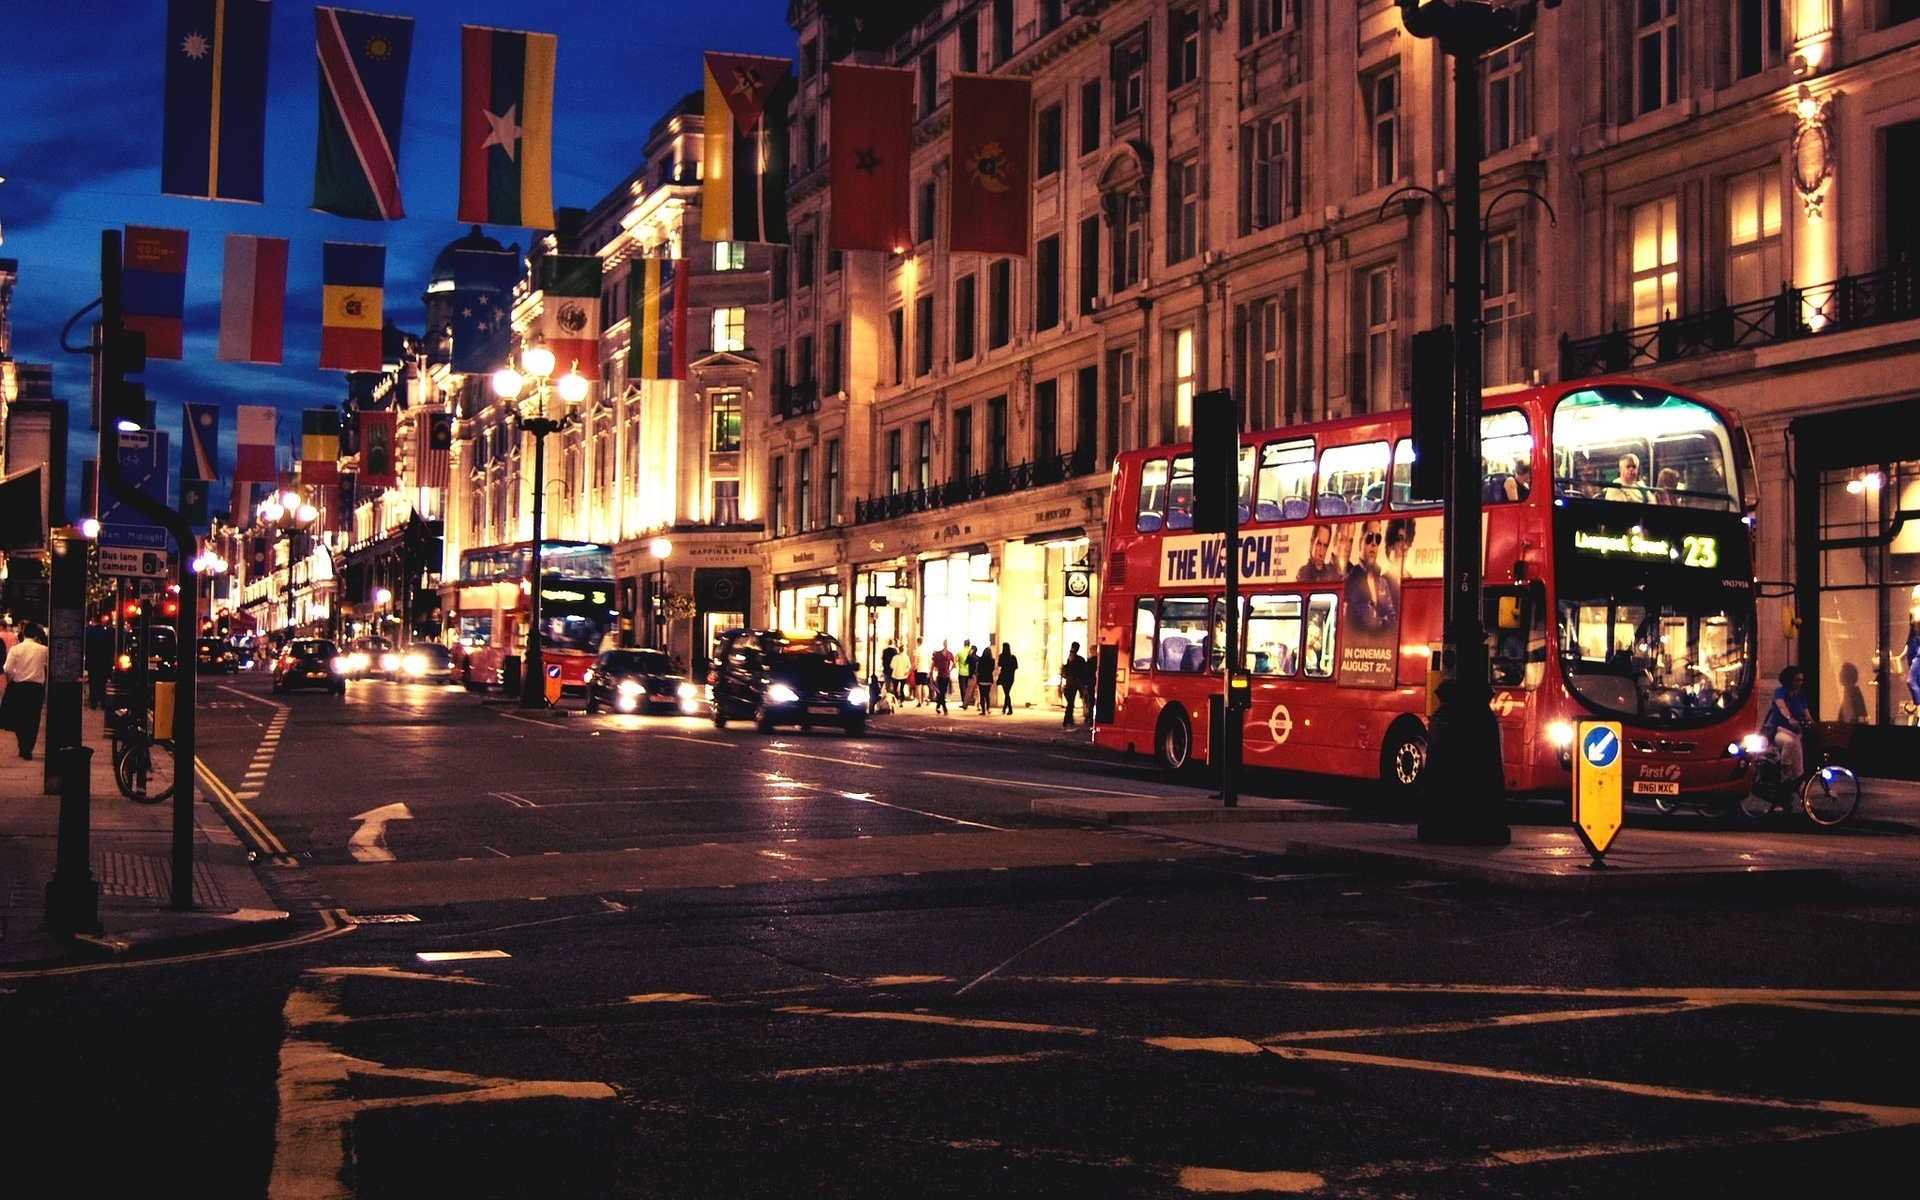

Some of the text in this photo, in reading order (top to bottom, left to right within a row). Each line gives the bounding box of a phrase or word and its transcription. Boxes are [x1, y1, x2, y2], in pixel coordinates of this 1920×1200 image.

[128, 532, 162, 542] Midnight
[102, 550, 138, 561] Bus lane
[1683, 535, 1717, 568] 23
[102, 563, 137, 571] cameras
[1167, 549, 1198, 580] THE
[1344, 648, 1392, 660] IN CINEMAS
[1341, 661, 1374, 672] AUGUST
[1640, 764, 1664, 778] First
[1638, 783, 1674, 792] BN61 MXC
